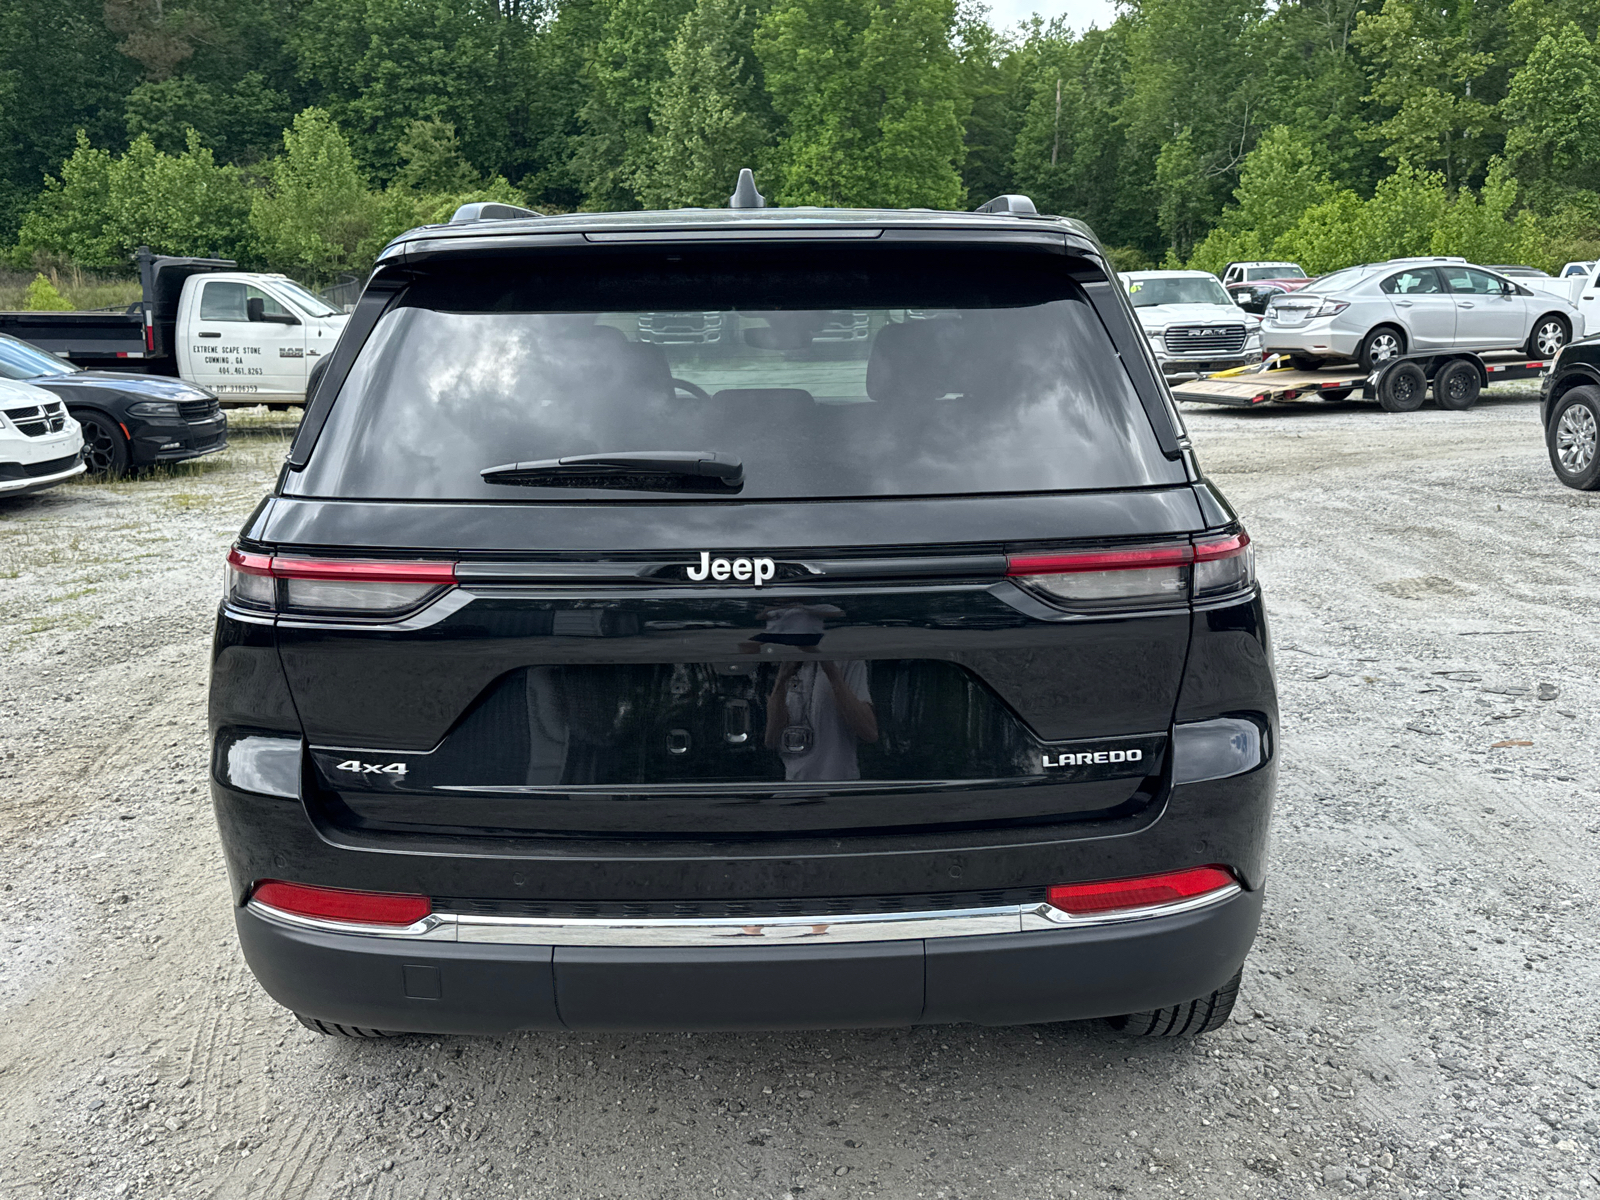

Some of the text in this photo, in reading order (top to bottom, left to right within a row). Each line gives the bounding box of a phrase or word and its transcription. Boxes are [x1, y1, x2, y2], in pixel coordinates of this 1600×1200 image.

[193, 345, 262, 355] EXTREME SCAPE STONE
[686, 552, 775, 586] Jeep
[1042, 749, 1142, 767] LAREDO
[336, 760, 409, 775] 4x4
